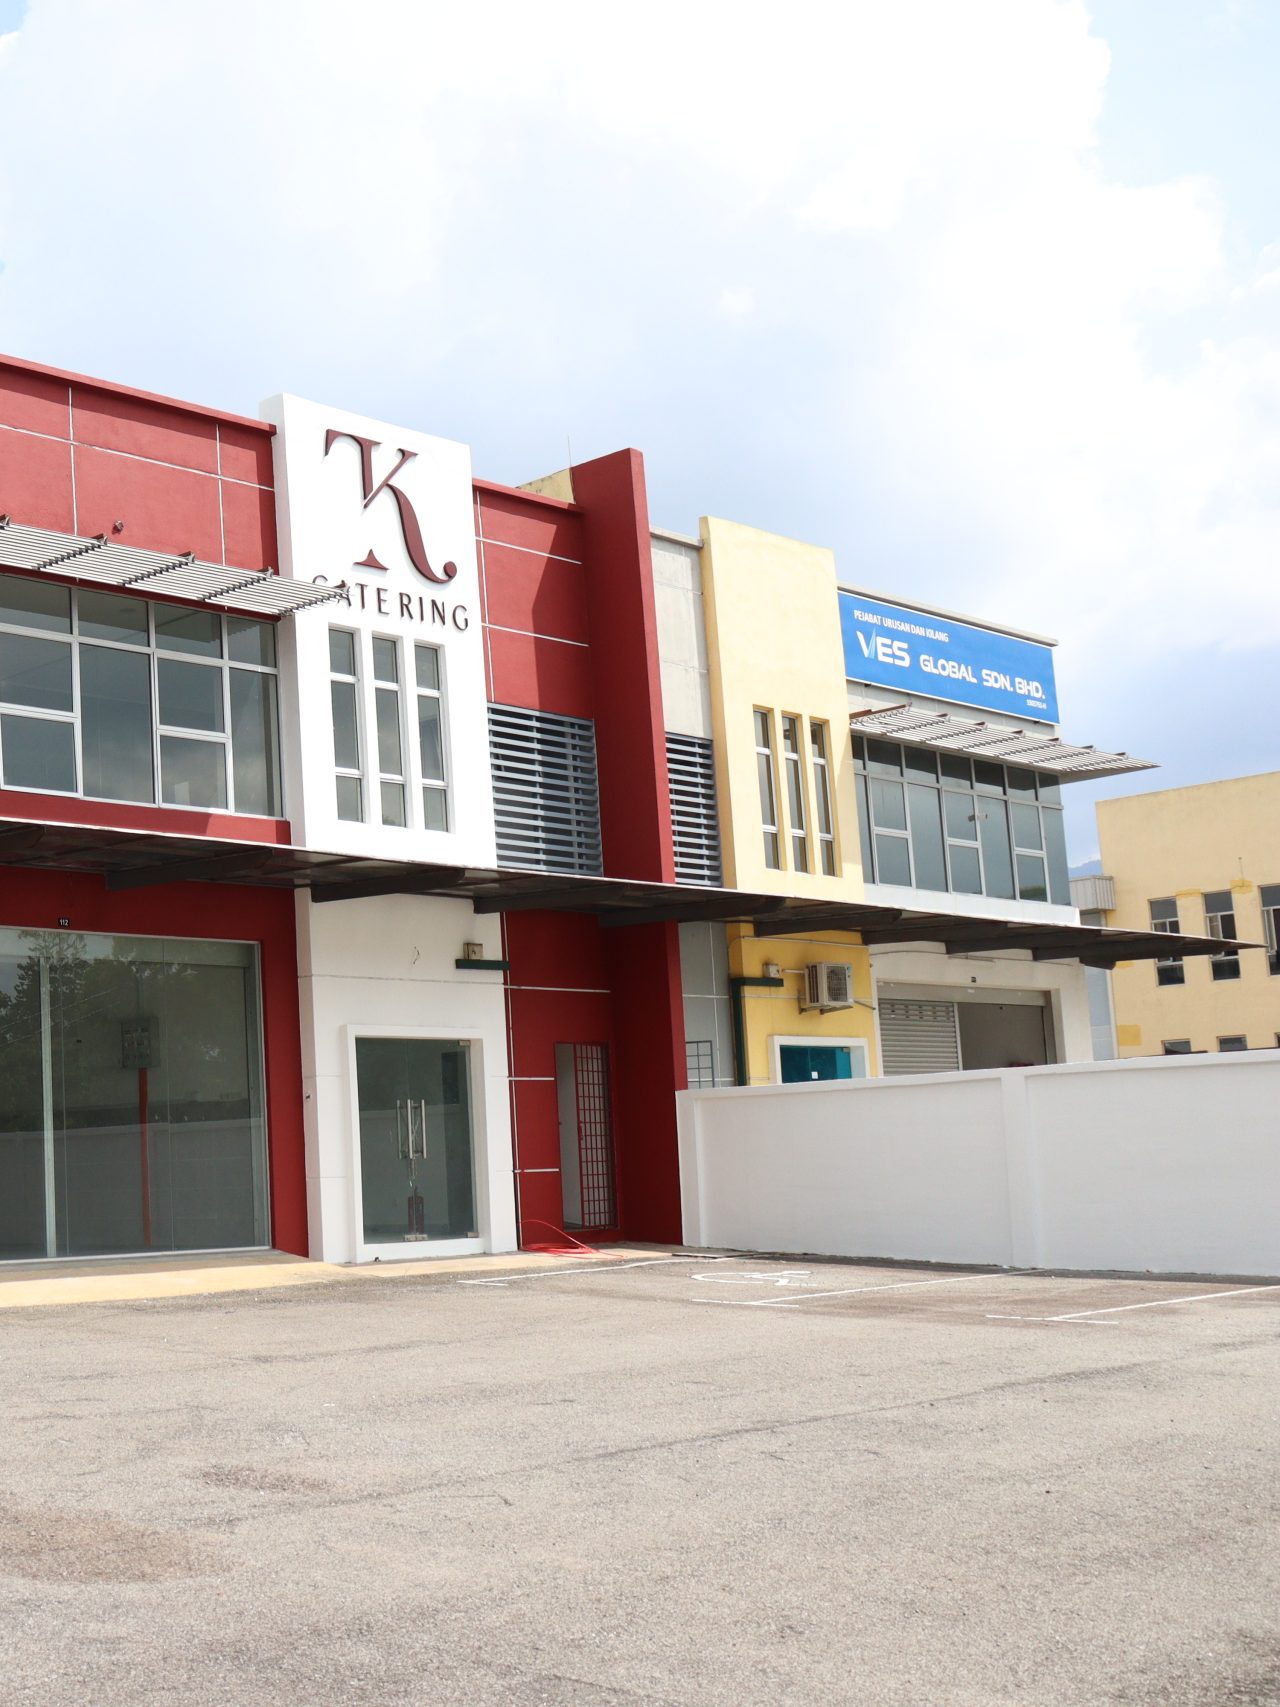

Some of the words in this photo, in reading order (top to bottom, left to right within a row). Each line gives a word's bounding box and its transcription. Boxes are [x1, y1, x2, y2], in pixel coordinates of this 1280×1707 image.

[853, 609, 881, 626] PEJABAT
[882, 617, 910, 633] URUSAN
[910, 624, 925, 637] DAN
[925, 628, 950, 643] KILANG
[855, 628, 910, 668] VES
[919, 654, 978, 684] GLOBAL
[981, 669, 1014, 692] SDN.
[1015, 677, 1046, 699] BHD.
